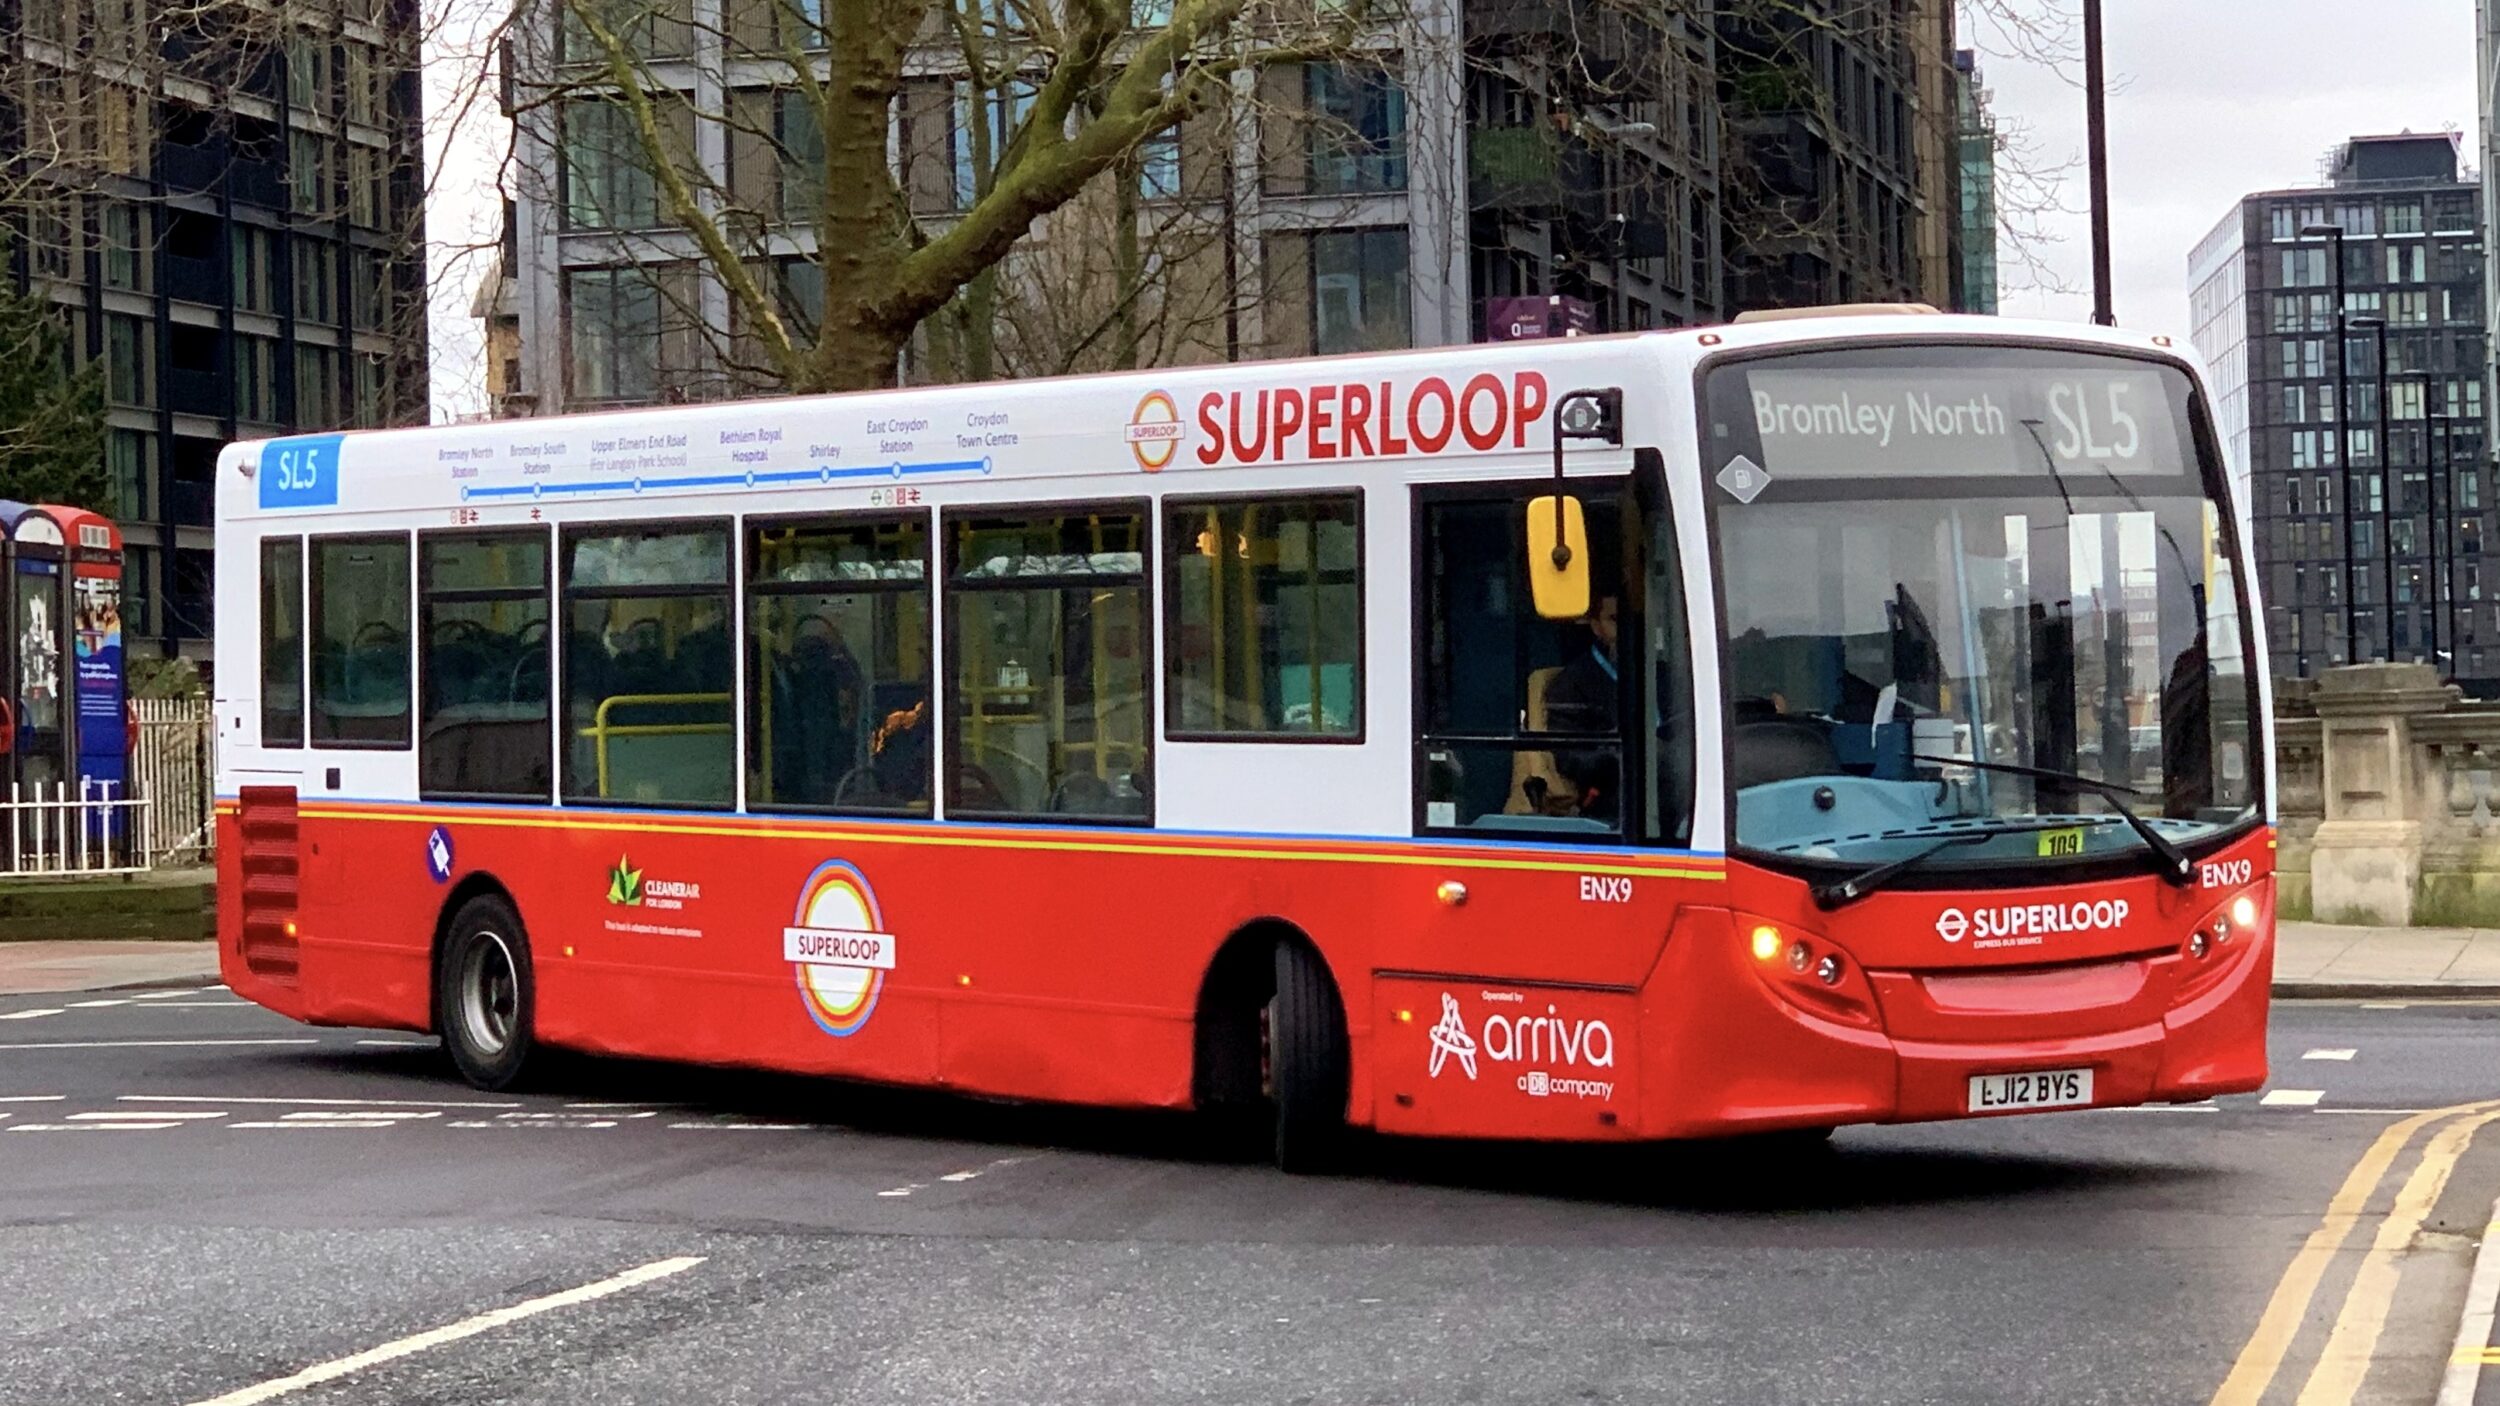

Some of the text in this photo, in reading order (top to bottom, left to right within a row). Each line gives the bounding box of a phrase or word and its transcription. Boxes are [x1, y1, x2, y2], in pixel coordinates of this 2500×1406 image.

[866, 417, 929, 435] East Croydon
[967, 411, 1009, 430] Croydon
[1196, 371, 1548, 464] SUPERLOOP
[1752, 389, 2005, 447] Bromley North
[2048, 382, 2139, 459] SL5
[719, 426, 783, 445] Bethlem Royal
[956, 432, 1018, 449] Town Centre
[1133, 425, 1178, 438] SUPERLOOP
[509, 441, 568, 459] Bromley South
[591, 433, 688, 454] Upper Elmers End Road
[808, 442, 841, 459] Shirley
[880, 439, 914, 454] Station
[438, 446, 494, 462] Bromley North
[731, 448, 769, 463] Hospital
[277, 448, 318, 491] SL5
[451, 465, 479, 479] Station
[522, 461, 552, 475] Station
[2048, 833, 2078, 855] 109
[2202, 859, 2251, 889] ENX9
[1580, 875, 1632, 902] ENX9
[1973, 899, 2129, 938] SUPERLOOP
[798, 935, 881, 960] SUPERLOOP
[1973, 939, 2002, 950] EXPRESS
[2016, 935, 2043, 946] SERVICE
[1481, 990, 1524, 1004] Operated by
[1483, 1003, 1614, 1069] arriva
[1517, 1076, 1527, 1091] a
[1549, 1078, 1615, 1102] company
[1981, 1073, 2079, 1106] LJ12 BYS
